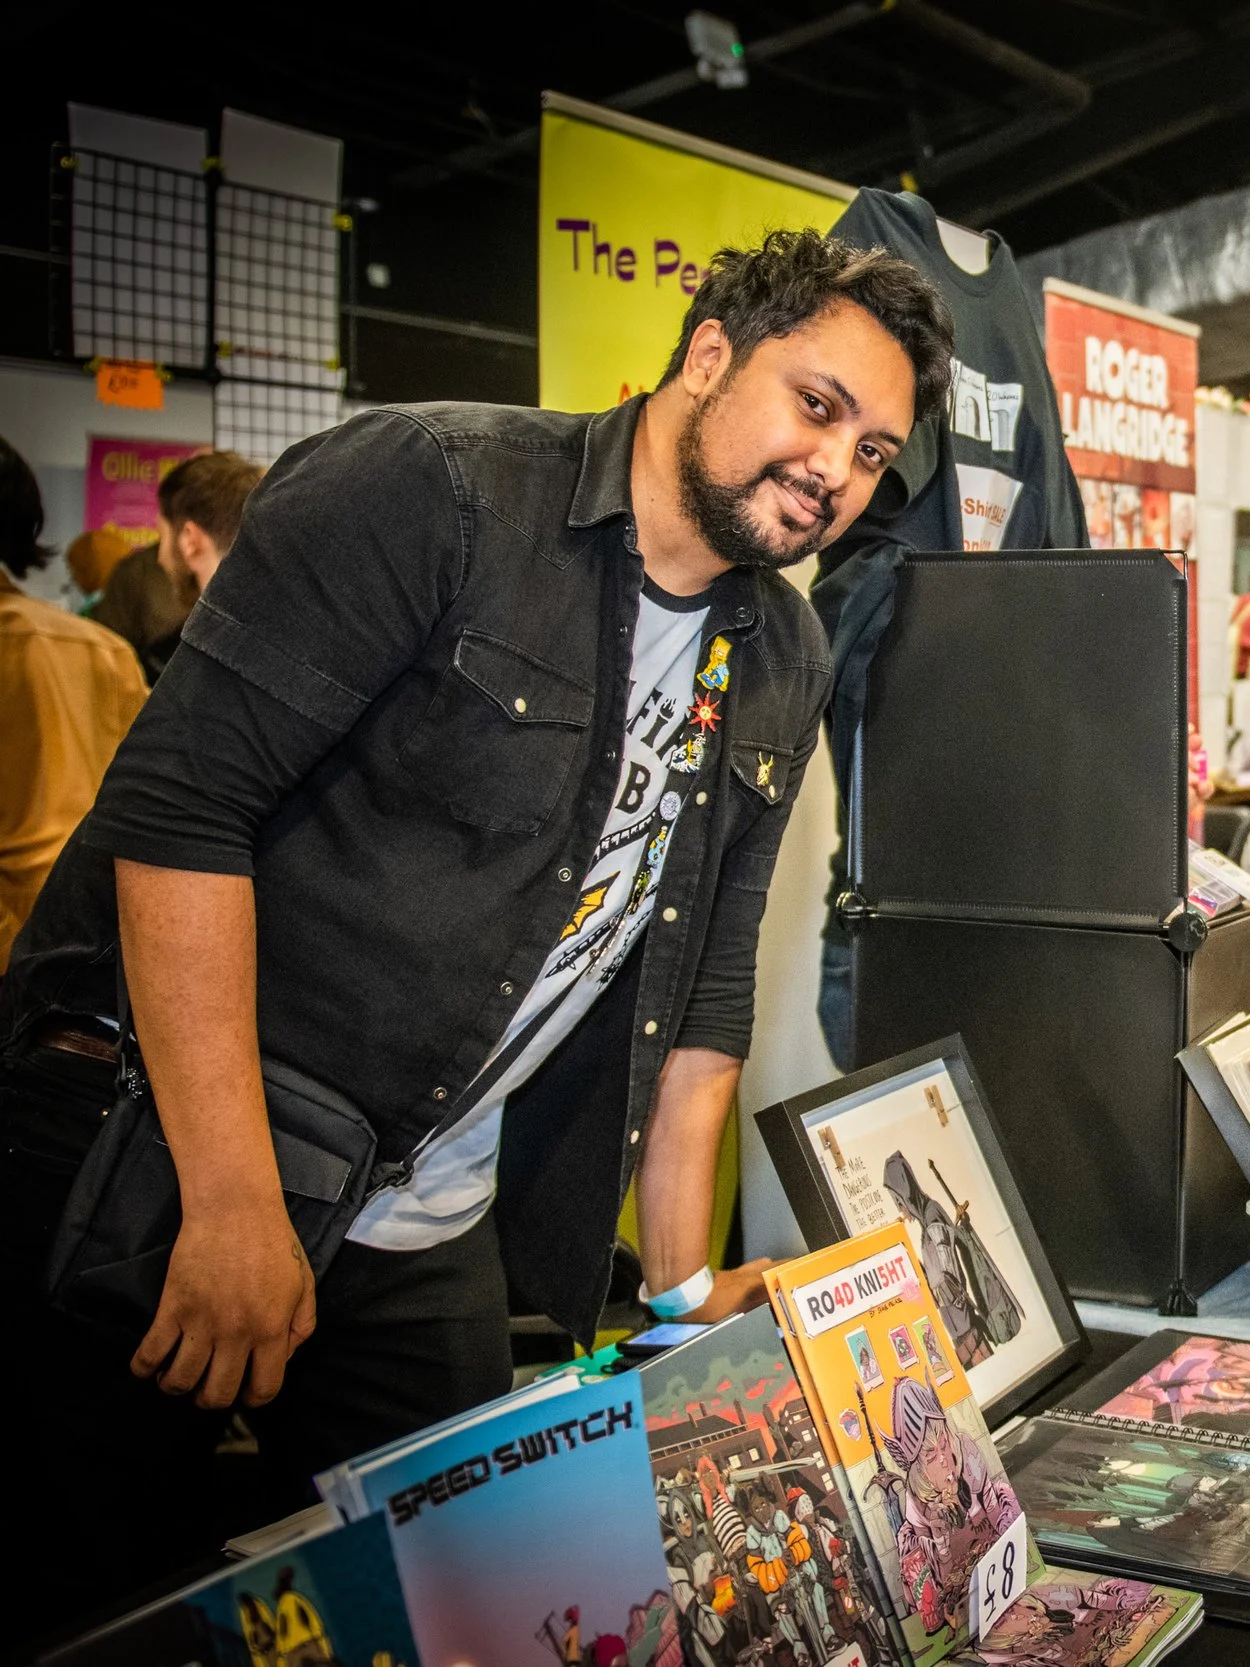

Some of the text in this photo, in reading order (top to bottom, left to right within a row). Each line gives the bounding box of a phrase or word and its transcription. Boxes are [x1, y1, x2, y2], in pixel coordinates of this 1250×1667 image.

[556, 219, 709, 296] The Pe
[1085, 336, 1168, 409] ROGER
[1062, 392, 1189, 466] LANGRIDGE
[807, 1282, 854, 1321] RO4D
[854, 1256, 907, 1299] KNI5HT
[388, 1401, 632, 1526] SPEED SWITCH
